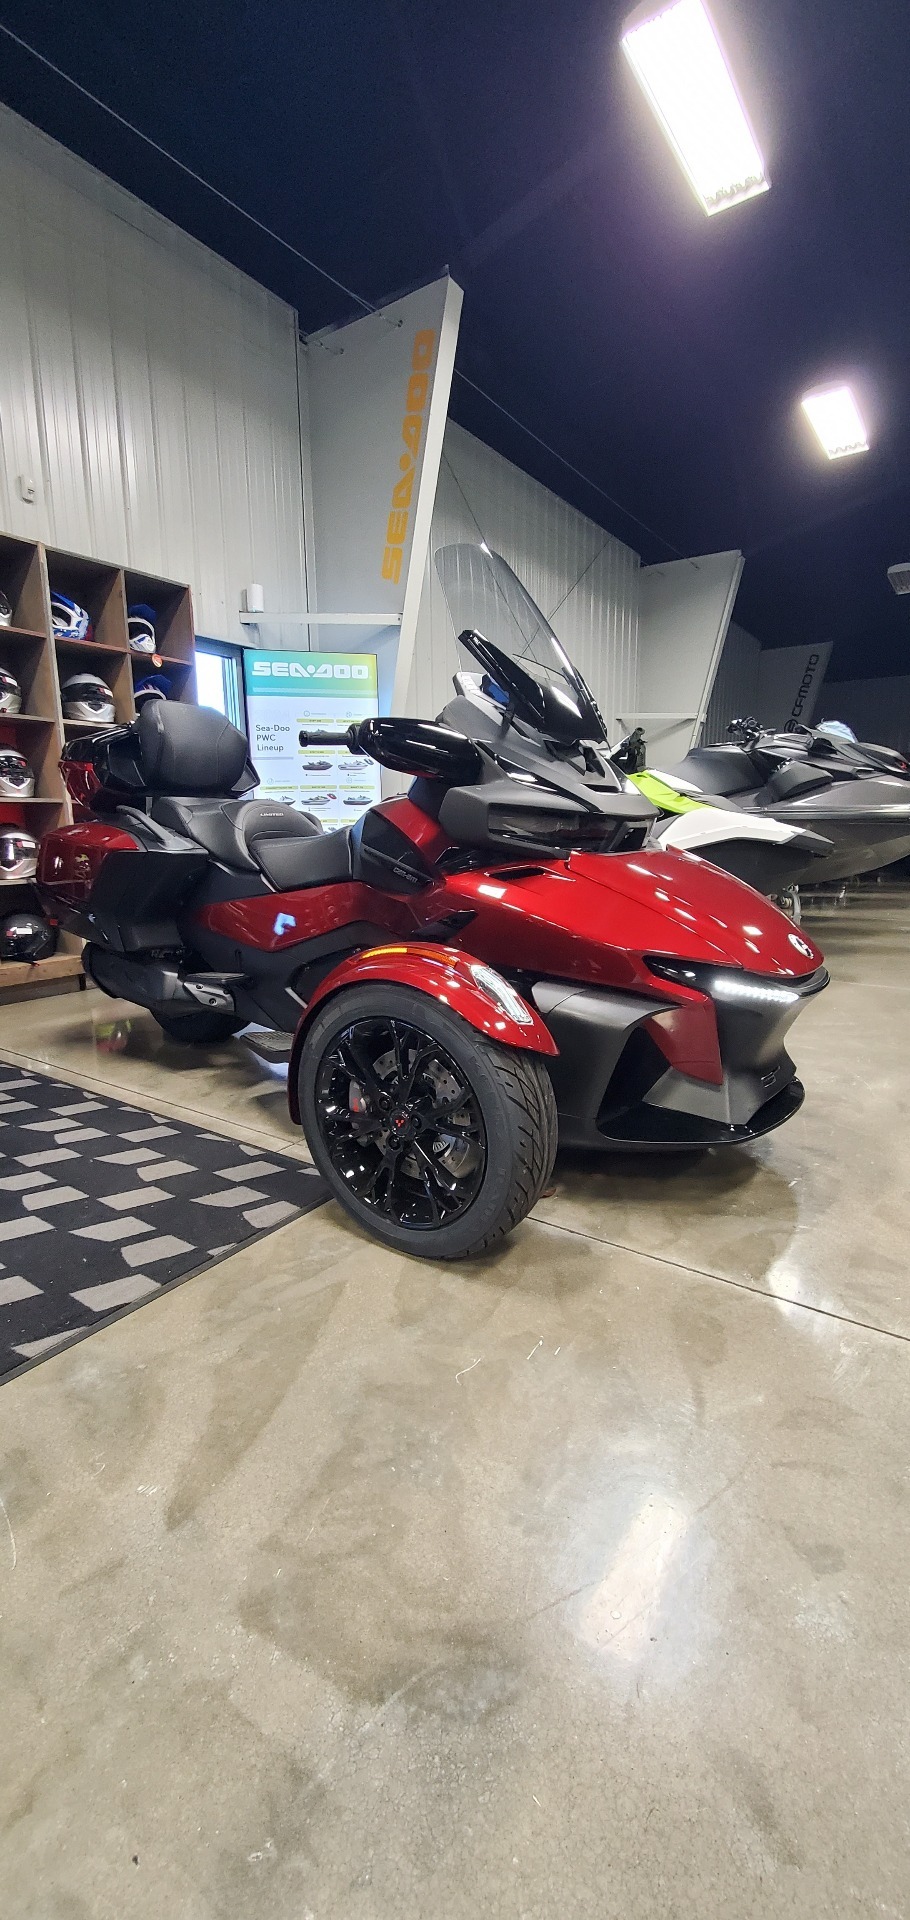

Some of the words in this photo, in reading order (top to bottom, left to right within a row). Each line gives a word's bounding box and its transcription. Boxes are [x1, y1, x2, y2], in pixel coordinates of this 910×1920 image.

[792, 654, 820, 717] CFMOTO
[255, 724, 291, 732] Sea-Doo
[257, 744, 284, 752] Lineup
